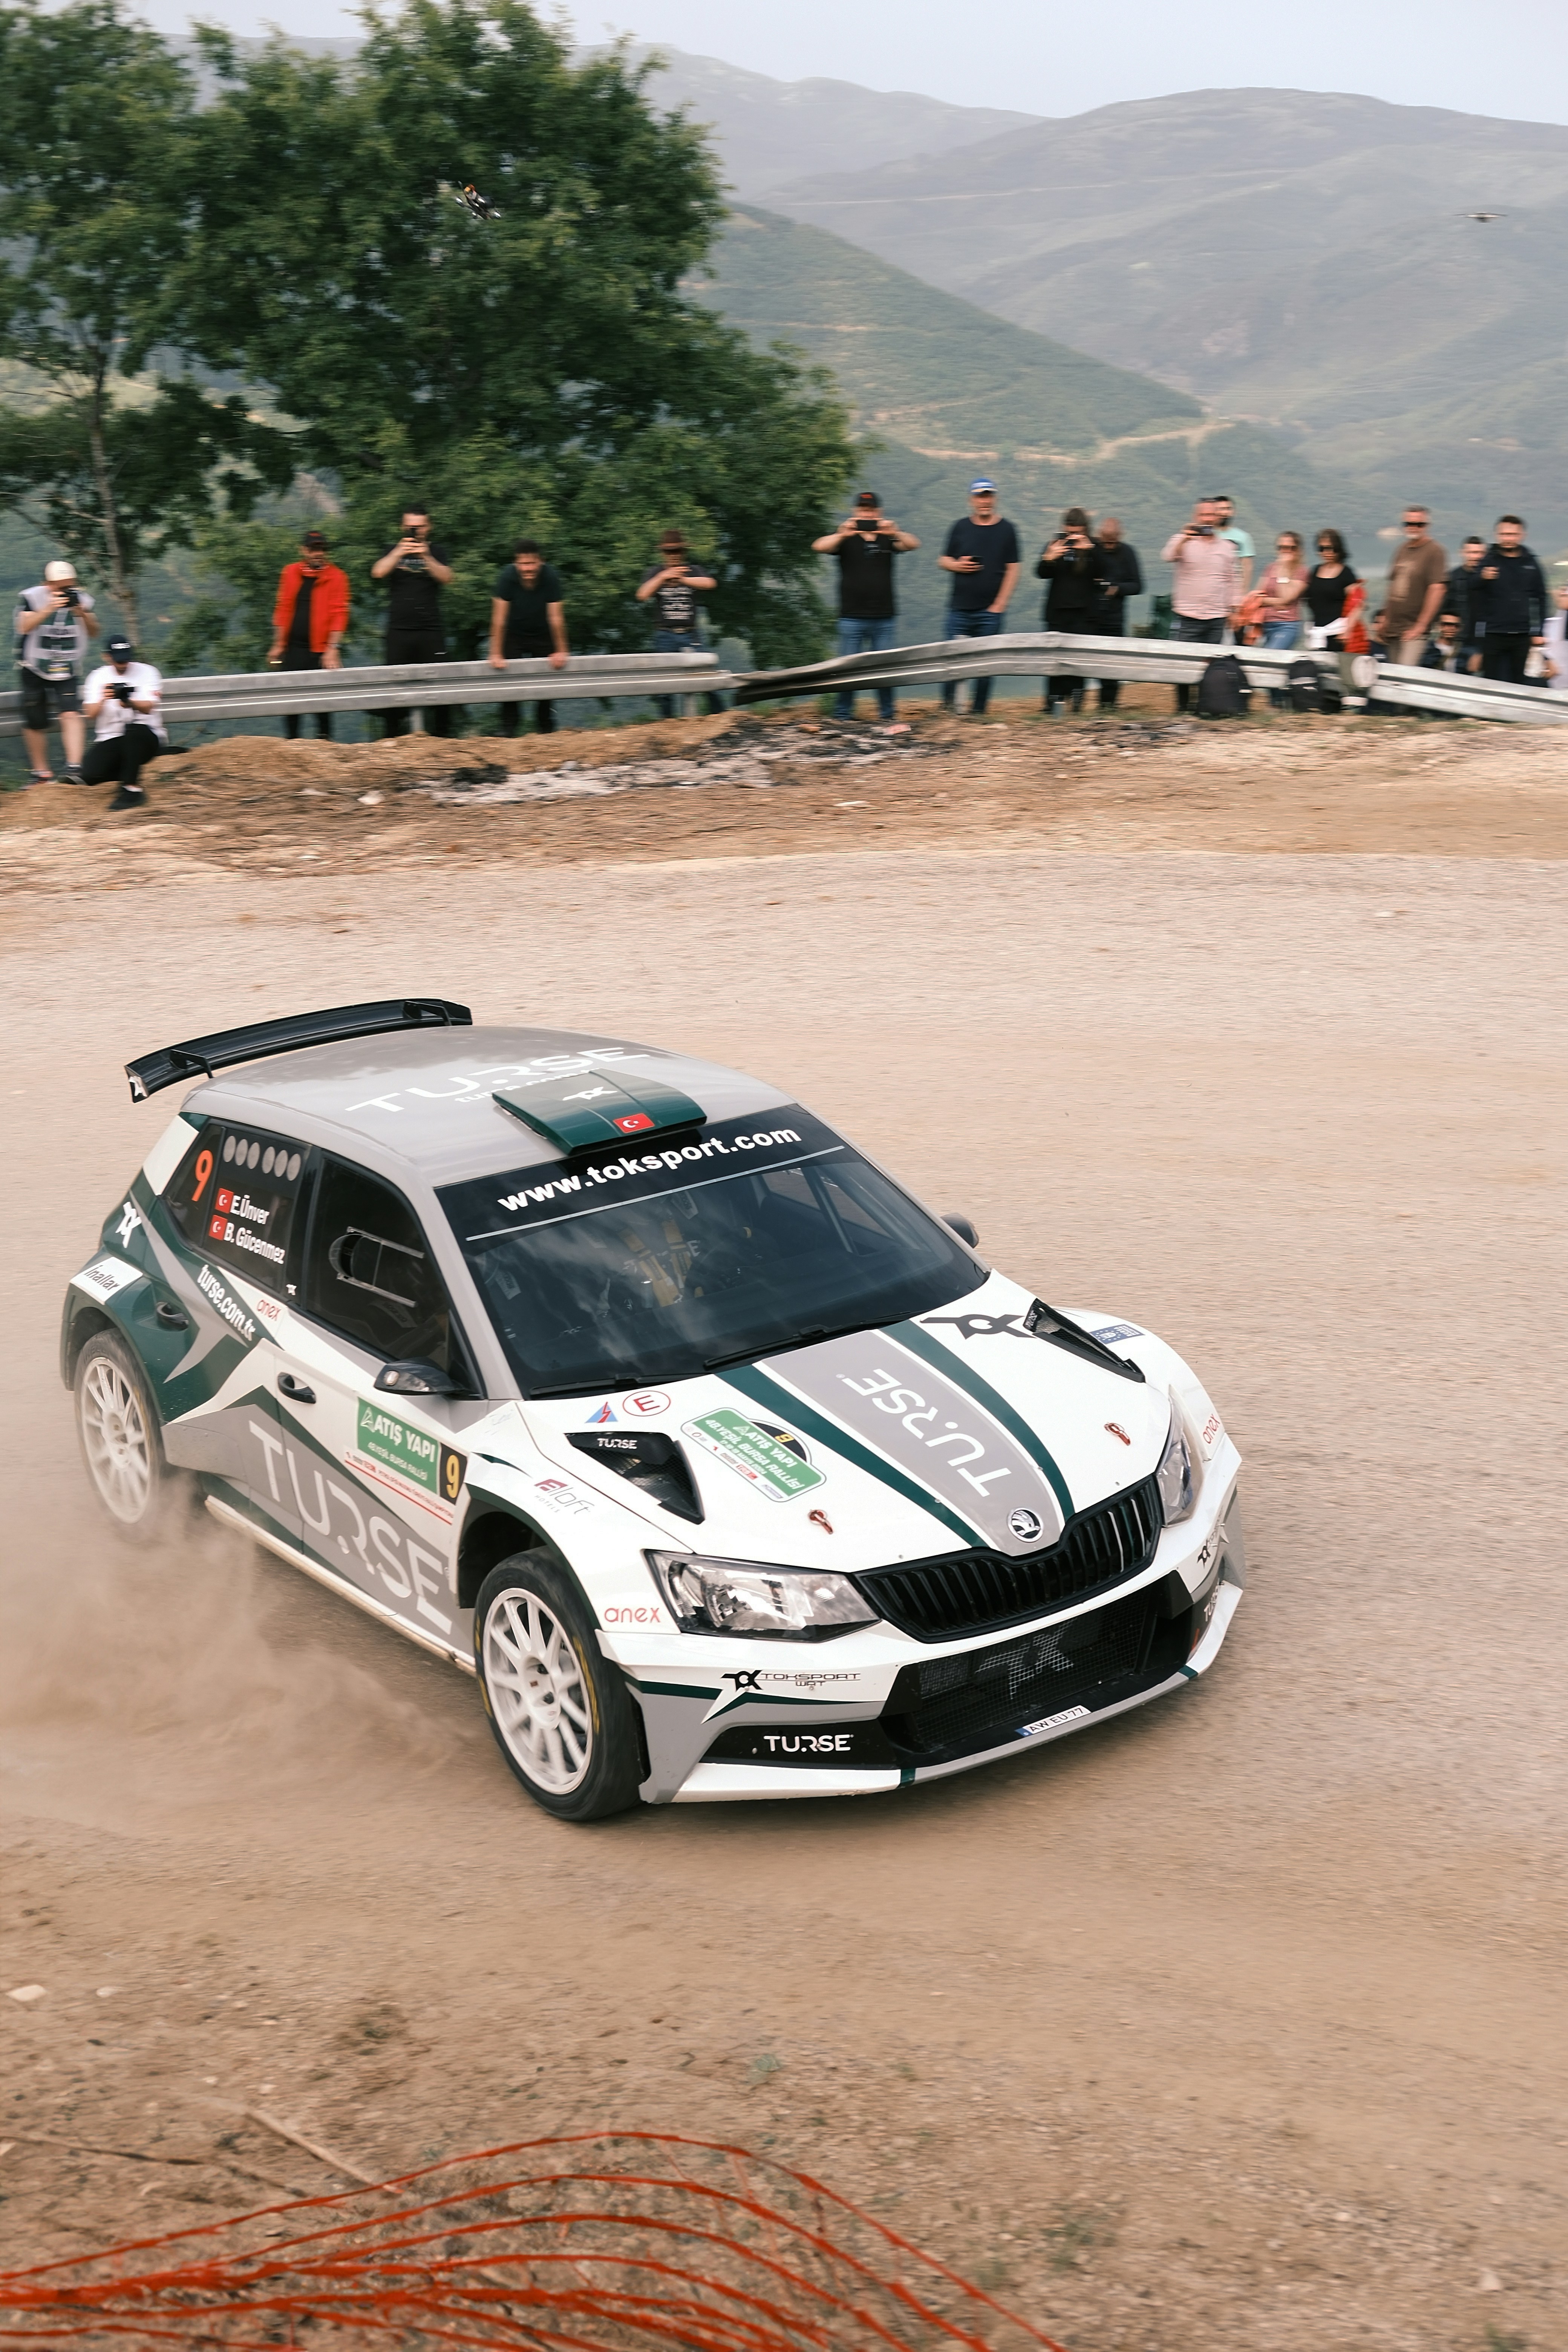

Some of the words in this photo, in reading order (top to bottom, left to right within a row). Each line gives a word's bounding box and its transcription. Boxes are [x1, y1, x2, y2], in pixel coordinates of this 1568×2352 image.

[345, 1047, 650, 1112] TURSE
[191, 1150, 213, 1202] 9
[497, 1129, 802, 1211] www.toksport.com
[224, 1222, 235, 1243] B.
[236, 1227, 286, 1264] Gücenmez
[197, 1264, 256, 1341] turse.com.tr
[257, 1299, 281, 1321] anex
[633, 1395, 660, 1412] E
[374, 1415, 403, 1446] ATIŞ
[406, 1430, 436, 1462] YAPI
[597, 1438, 638, 1449] TURSE
[744, 1432, 773, 1449] ATIŞ
[770, 1447, 798, 1467] YAPI
[841, 1368, 1012, 1498] TURSE
[1203, 1413, 1220, 1444] anex
[446, 1455, 459, 1498] 9
[737, 1443, 771, 1465] BURSA
[765, 1464, 805, 1489] RALLİSİ
[534, 1495, 560, 1513] HOTELS
[249, 1420, 452, 1635] TURSE
[604, 1606, 661, 1623] anex
[1029, 1720, 1049, 1732] AW
[1049, 1714, 1068, 1723] EU
[1067, 1707, 1083, 1717] 77
[763, 1734, 851, 1752] TURSE
